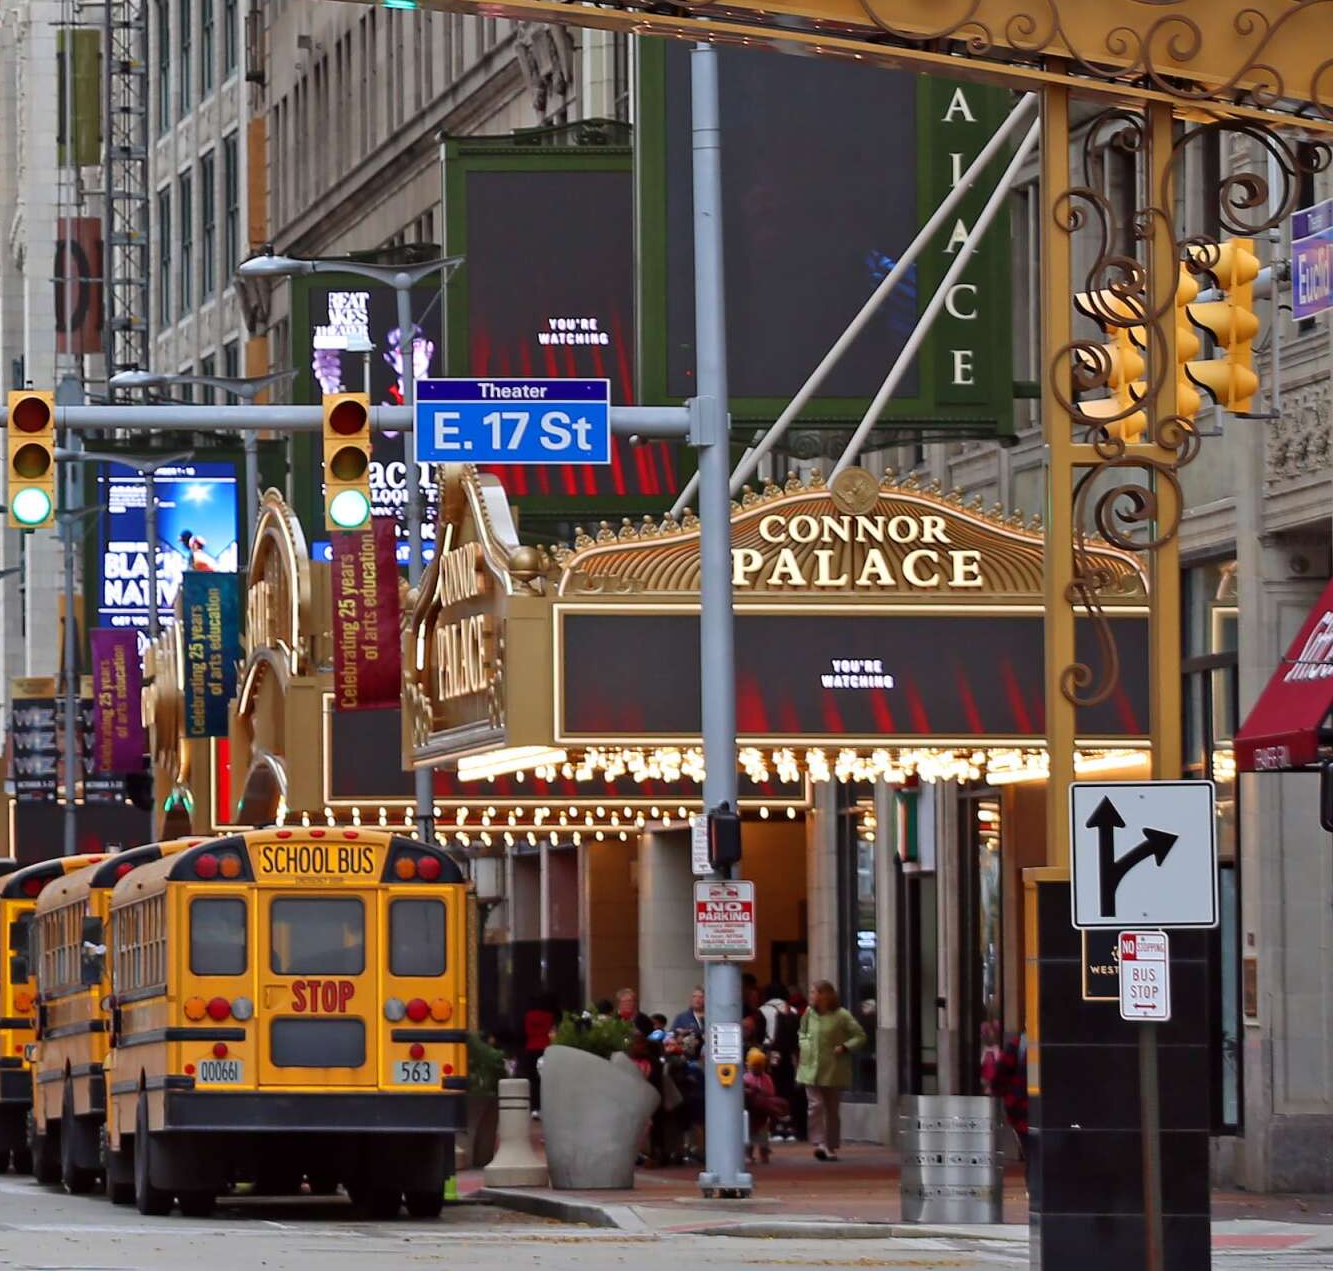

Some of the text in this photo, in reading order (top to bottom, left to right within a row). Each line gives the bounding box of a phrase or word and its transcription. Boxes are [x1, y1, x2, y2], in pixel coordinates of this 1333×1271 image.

[548, 318, 598, 331] YOU'RE
[538, 332, 609, 345] WATCHING
[477, 382, 548, 399] Theater
[434, 411, 592, 451] E. 17 St
[758, 514, 952, 544] CONNOR
[730, 548, 983, 588] PALACE
[358, 533, 379, 661] of arts education
[190, 604, 206, 640] years
[208, 587, 222, 650] education
[338, 553, 360, 708] Celebrating 25 years
[188, 643, 205, 660] 25
[832, 659, 882, 673] YOU'RE
[820, 674, 894, 688] WATCHING
[262, 846, 374, 875] SCHOOL BUS
[706, 902, 743, 912] NO
[698, 911, 750, 921] PARKING
[1122, 940, 1135, 954] NO
[1132, 968, 1156, 982] BUS
[291, 980, 355, 1013] STOP
[1130, 985, 1159, 999] STOP
[401, 1061, 431, 1083] 563
